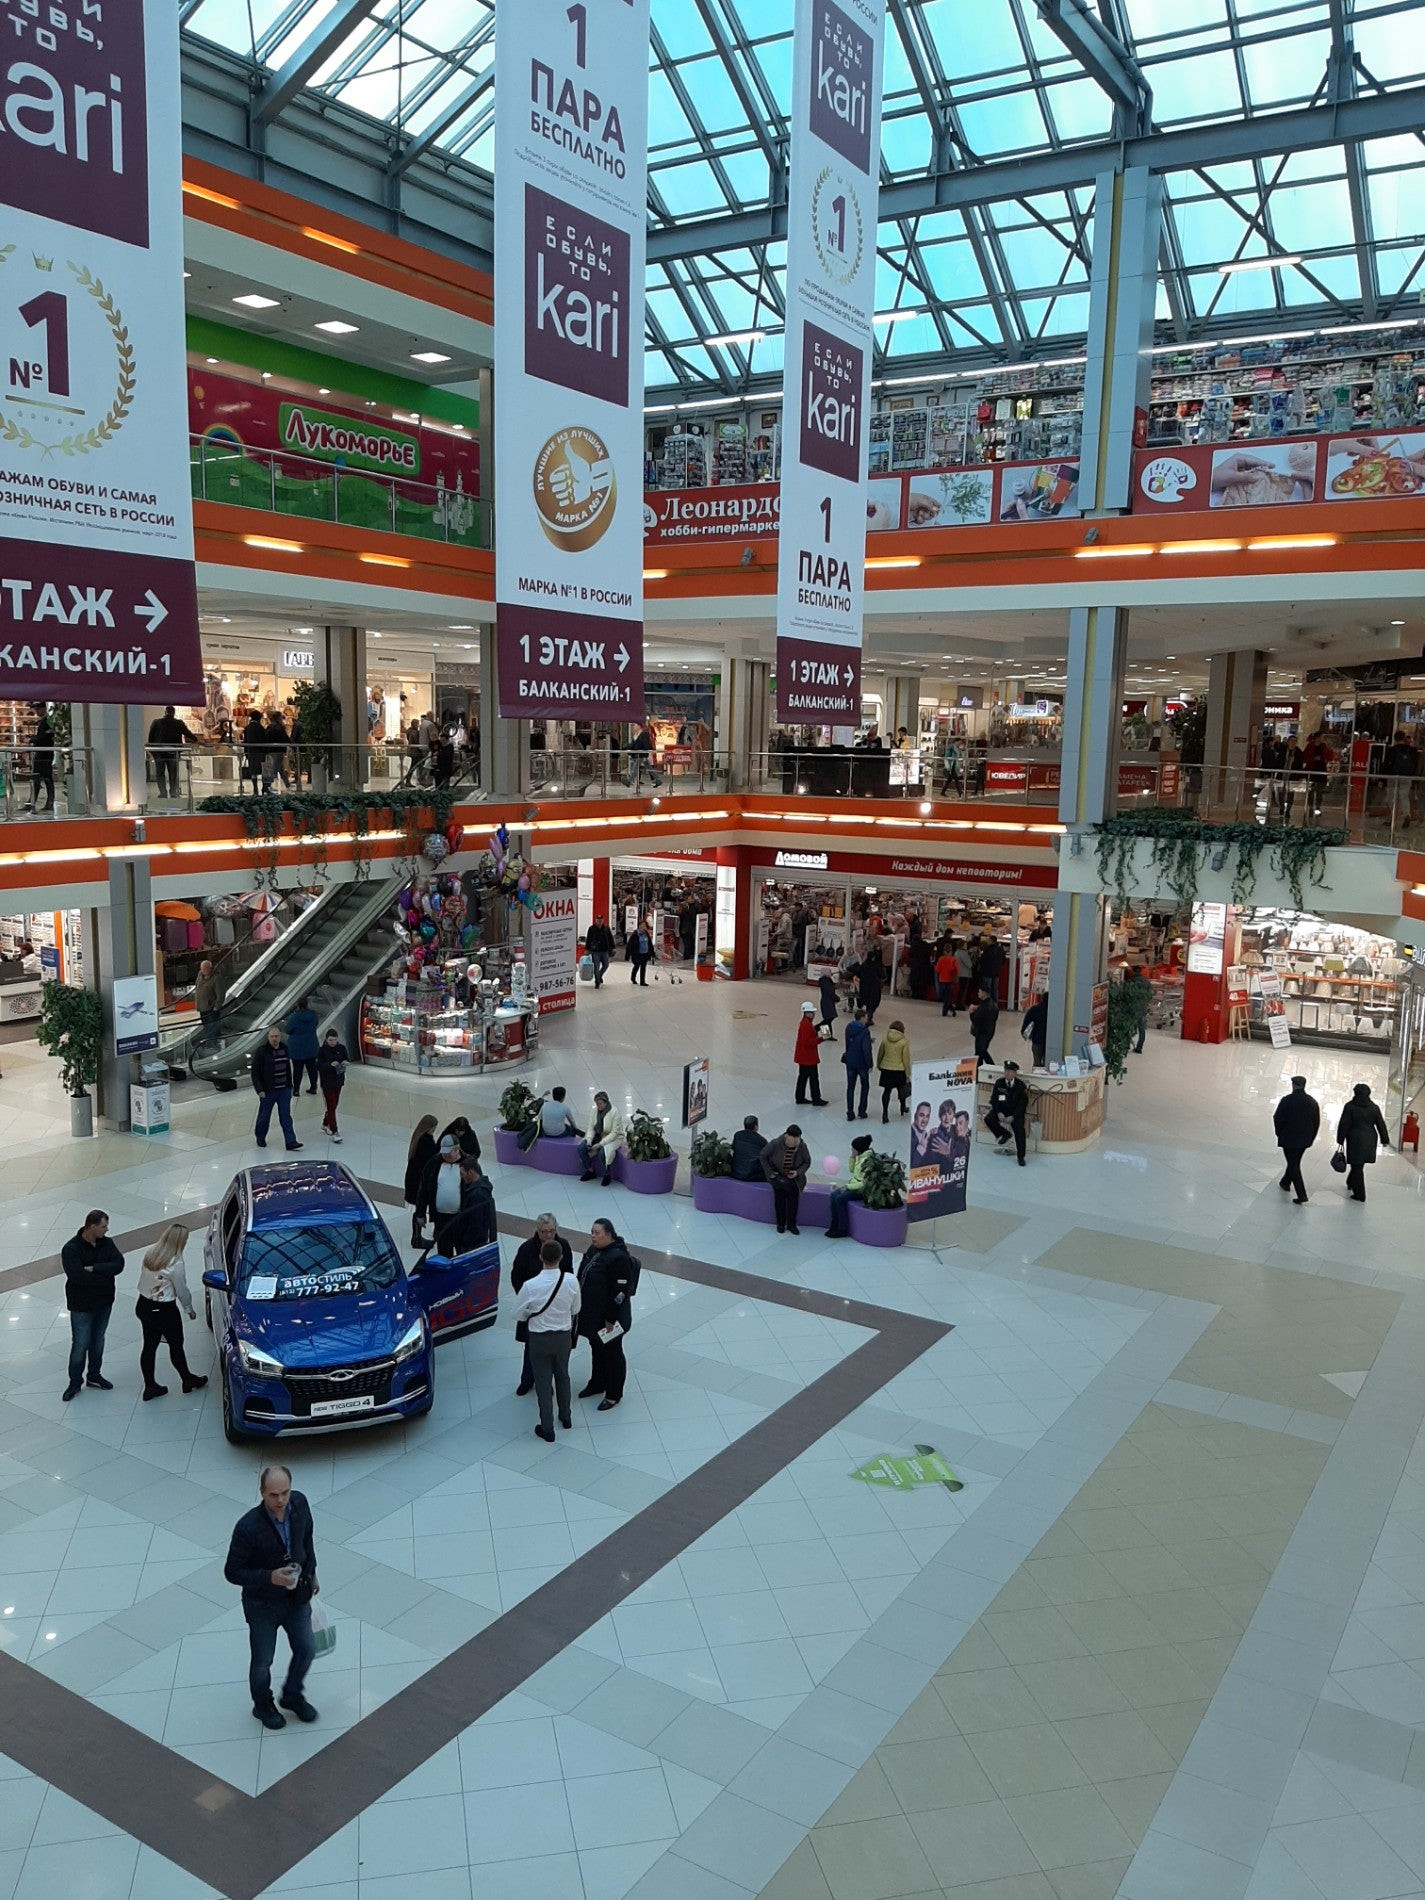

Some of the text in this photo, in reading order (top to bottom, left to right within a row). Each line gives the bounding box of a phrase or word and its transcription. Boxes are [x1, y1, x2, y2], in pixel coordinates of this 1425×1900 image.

[8, 13, 57, 52] ТО
[566, 3, 587, 70] 1
[824, 26, 862, 68] ОБУВЬ,
[825, 12, 863, 54] ЕСЛИ
[837, 51, 850, 69] ТО
[818, 39, 865, 134] kari
[0, 61, 124, 175] ari
[531, 57, 626, 153] ПАРА
[531, 111, 626, 180] БЕСПЛАТНО
[546, 215, 612, 257] ЕСЛИ
[546, 233, 612, 276] ОБУВЬ,
[568, 261, 591, 281] ТО
[538, 252, 618, 358] kari
[814, 342, 853, 370] ЕСЛИ
[814, 356, 852, 385] ОБУВЬ,
[826, 375, 840, 389] ТО
[807, 370, 855, 447] kari
[537, 430, 605, 491] ЛУЧШИЕ ИЗ ЛУЧШИХ
[48, 478, 95, 497] ОБУВИ
[98, 485, 108, 498] И
[110, 488, 157, 506] САМАЯ
[0, 491, 175, 527] ЗНИЧНАЯ СЕТЬ В РОССИИ
[555, 510, 588, 523] МАРКА
[819, 496, 832, 543] 1
[798, 549, 852, 593] ПАРА
[0, 578, 116, 628] ТАЖ
[518, 577, 632, 606] МАРКА №1 В РОССИИ
[798, 588, 851, 613] БЕСПЛАТНО
[519, 634, 606, 670] 1 ЭТАЖ
[790, 659, 839, 685] 1 ЭТАЖ
[519, 679, 631, 702] БАЛКАНСКИЙ-1
[788, 693, 854, 711] БАЛКАНСКИЙ-1
[892, 860, 1023, 880] Каждый дом неповторим!
[540, 976, 575, 991] 987-56-76
[946, 1077, 973, 1087] NOVA
[953, 1155, 966, 1168] 26
[908, 1170, 965, 1190] ИВАНУШКИ
[296, 1281, 360, 1297] 777-92-47
[330, 1401, 361, 1411] TIGGO
[362, 1398, 371, 1406] 4
